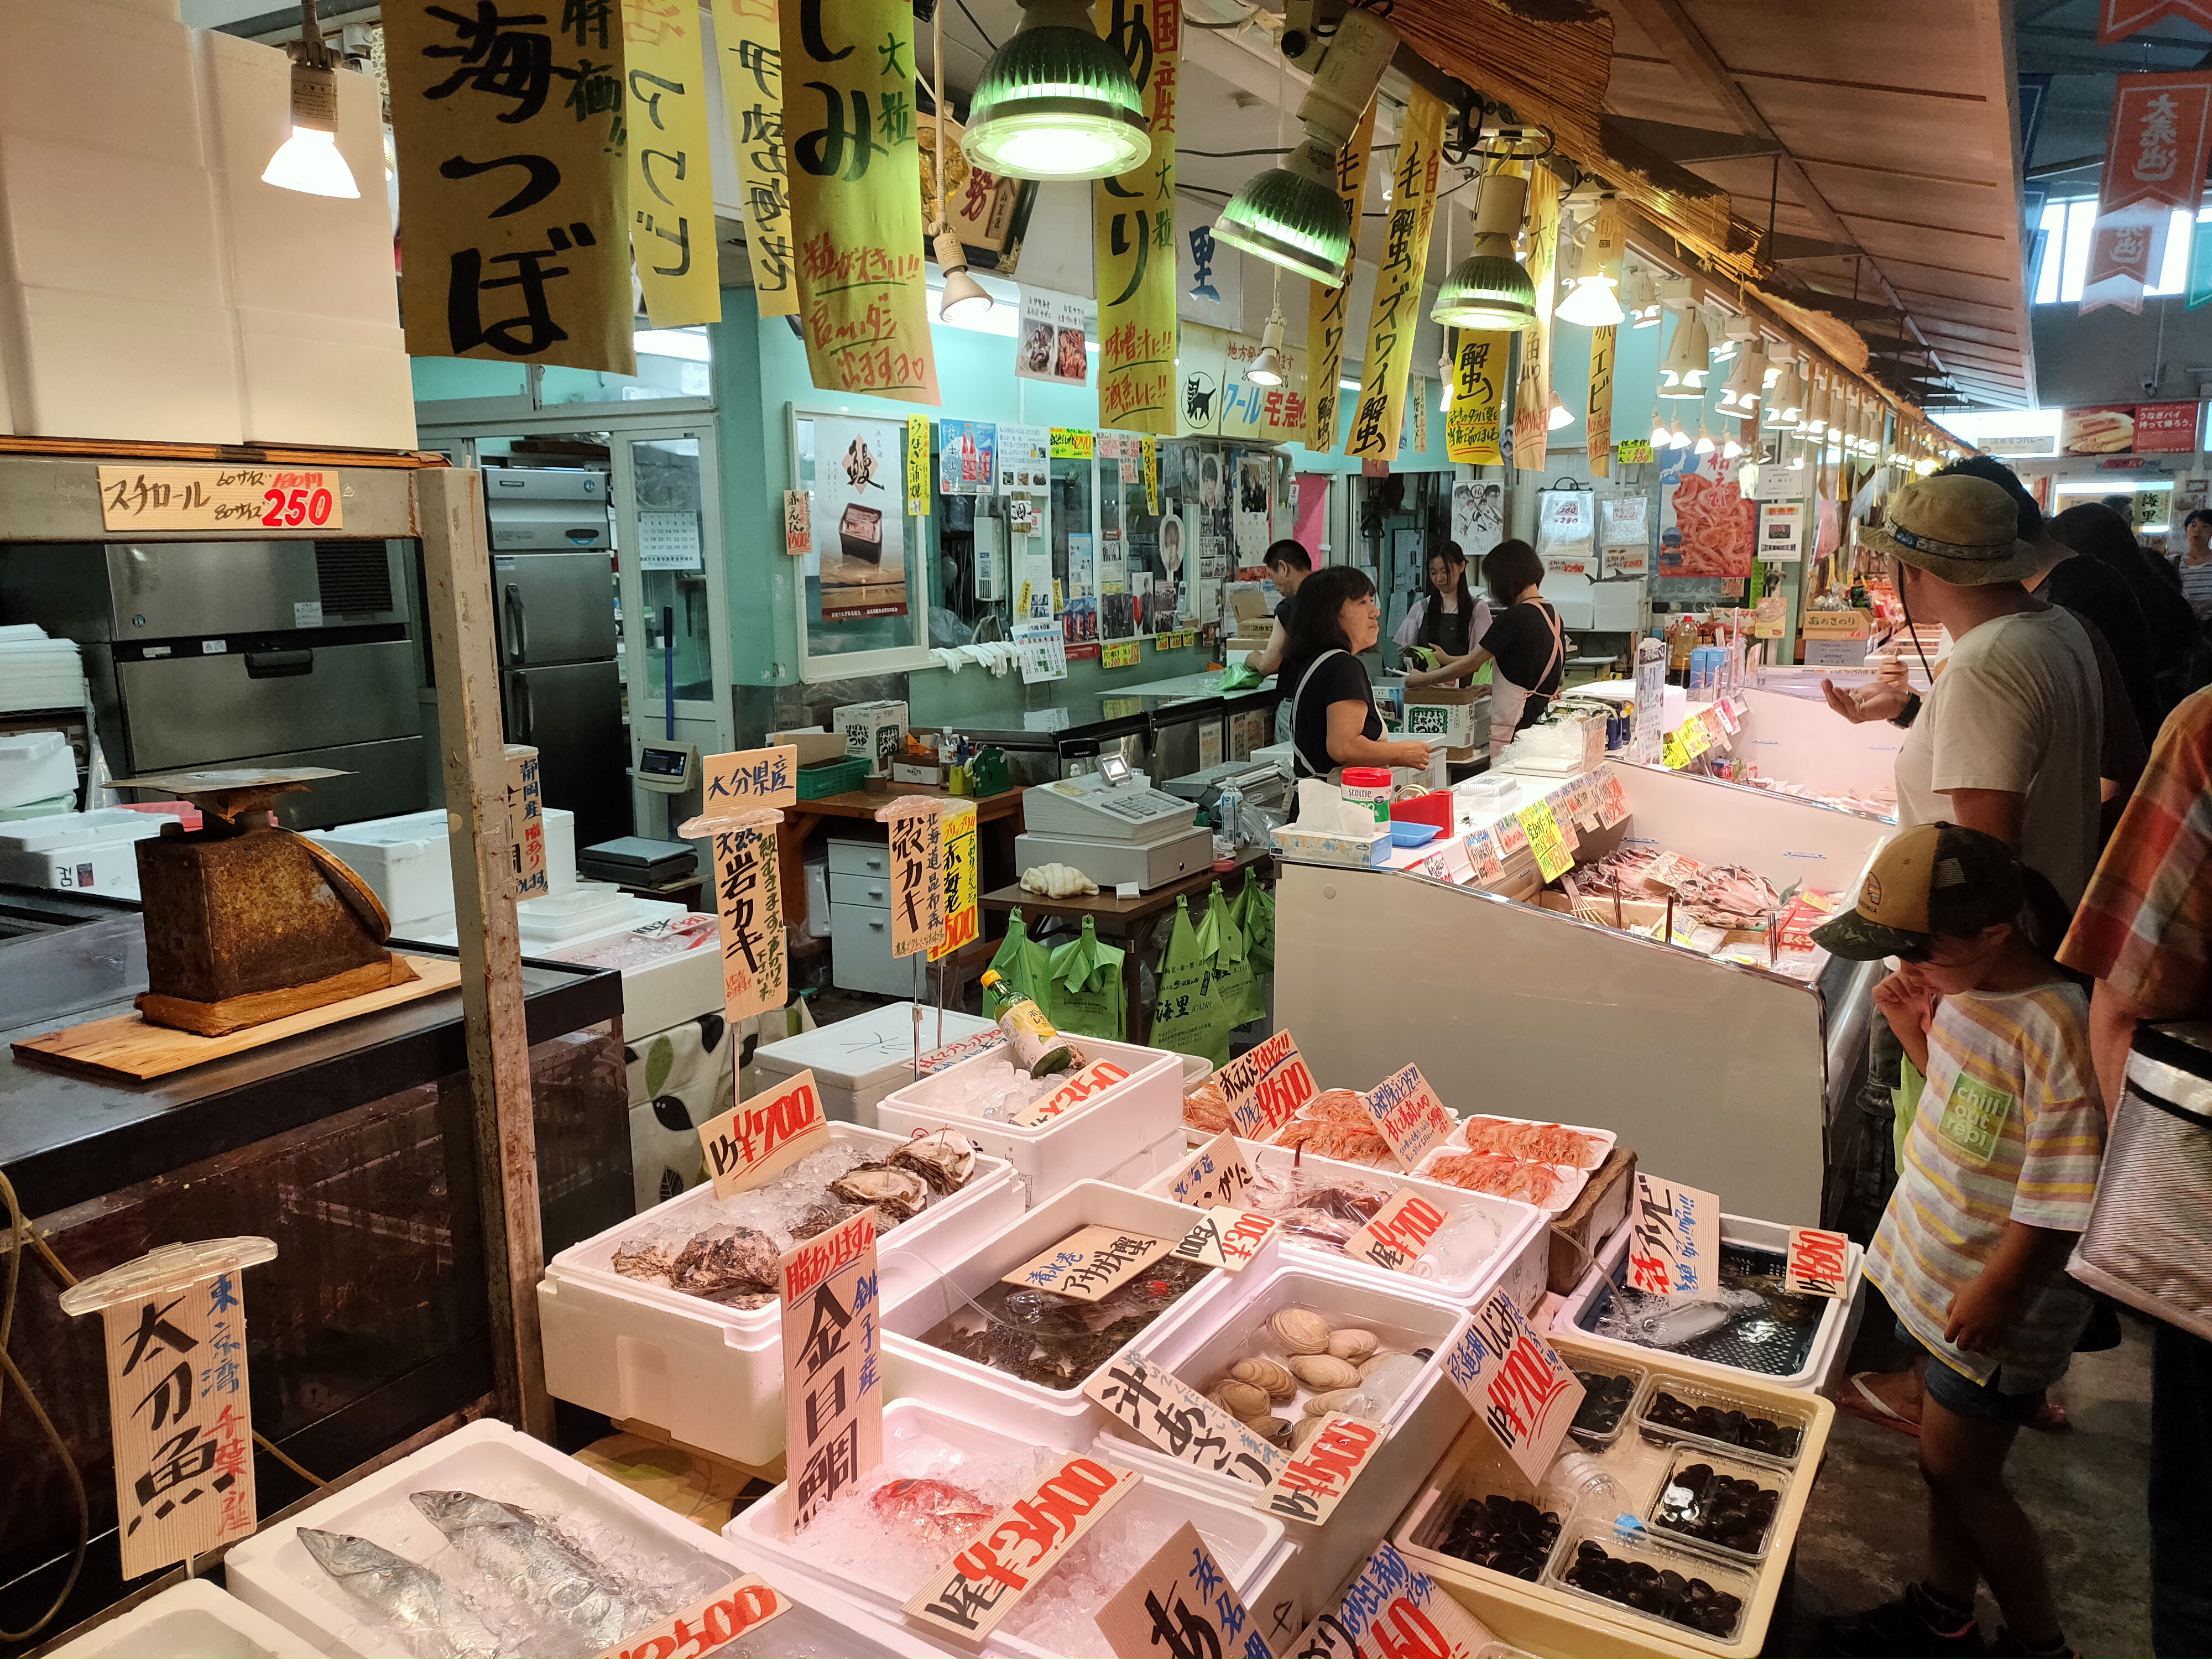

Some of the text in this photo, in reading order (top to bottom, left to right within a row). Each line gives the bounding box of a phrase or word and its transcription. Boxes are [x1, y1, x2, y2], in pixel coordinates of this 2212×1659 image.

[878, 32, 915, 145] 大粒
[1155, 159, 1173, 250] 大粒
[1223, 383, 1263, 425] クール
[104, 473, 211, 517] スチロール
[262, 487, 333, 527] 250
[708, 754, 794, 801] 大分県産
[1349, 789, 1371, 797] scottie
[925, 812, 944, 931] 北海道昆布森
[720, 851, 764, 974] 岩カキ
[1156, 994, 1213, 1024] 海里 KAIRI
[733, 1084, 816, 1164] ¥700
[1040, 1061, 1130, 1117] ¥350
[1255, 1060, 1312, 1130] ¥500
[1954, 1104, 1991, 1130] out
[1957, 1085, 2001, 1115] chill
[1222, 1213, 1276, 1260] ¥300
[1367, 1196, 1448, 1260] ¥700
[201, 1272, 241, 1397] 東京湾
[851, 1267, 881, 1404] 銚子産
[1472, 1296, 1520, 1361] しじみ
[121, 1295, 236, 1538] 太刀魚
[794, 1281, 859, 1527] 金目鯛
[1487, 1335, 1555, 1438] ¥700
[1101, 1366, 1274, 1488] 沖あさり
[1277, 1418, 1380, 1498] ¥500
[952, 1457, 1119, 1595] ¥3500
